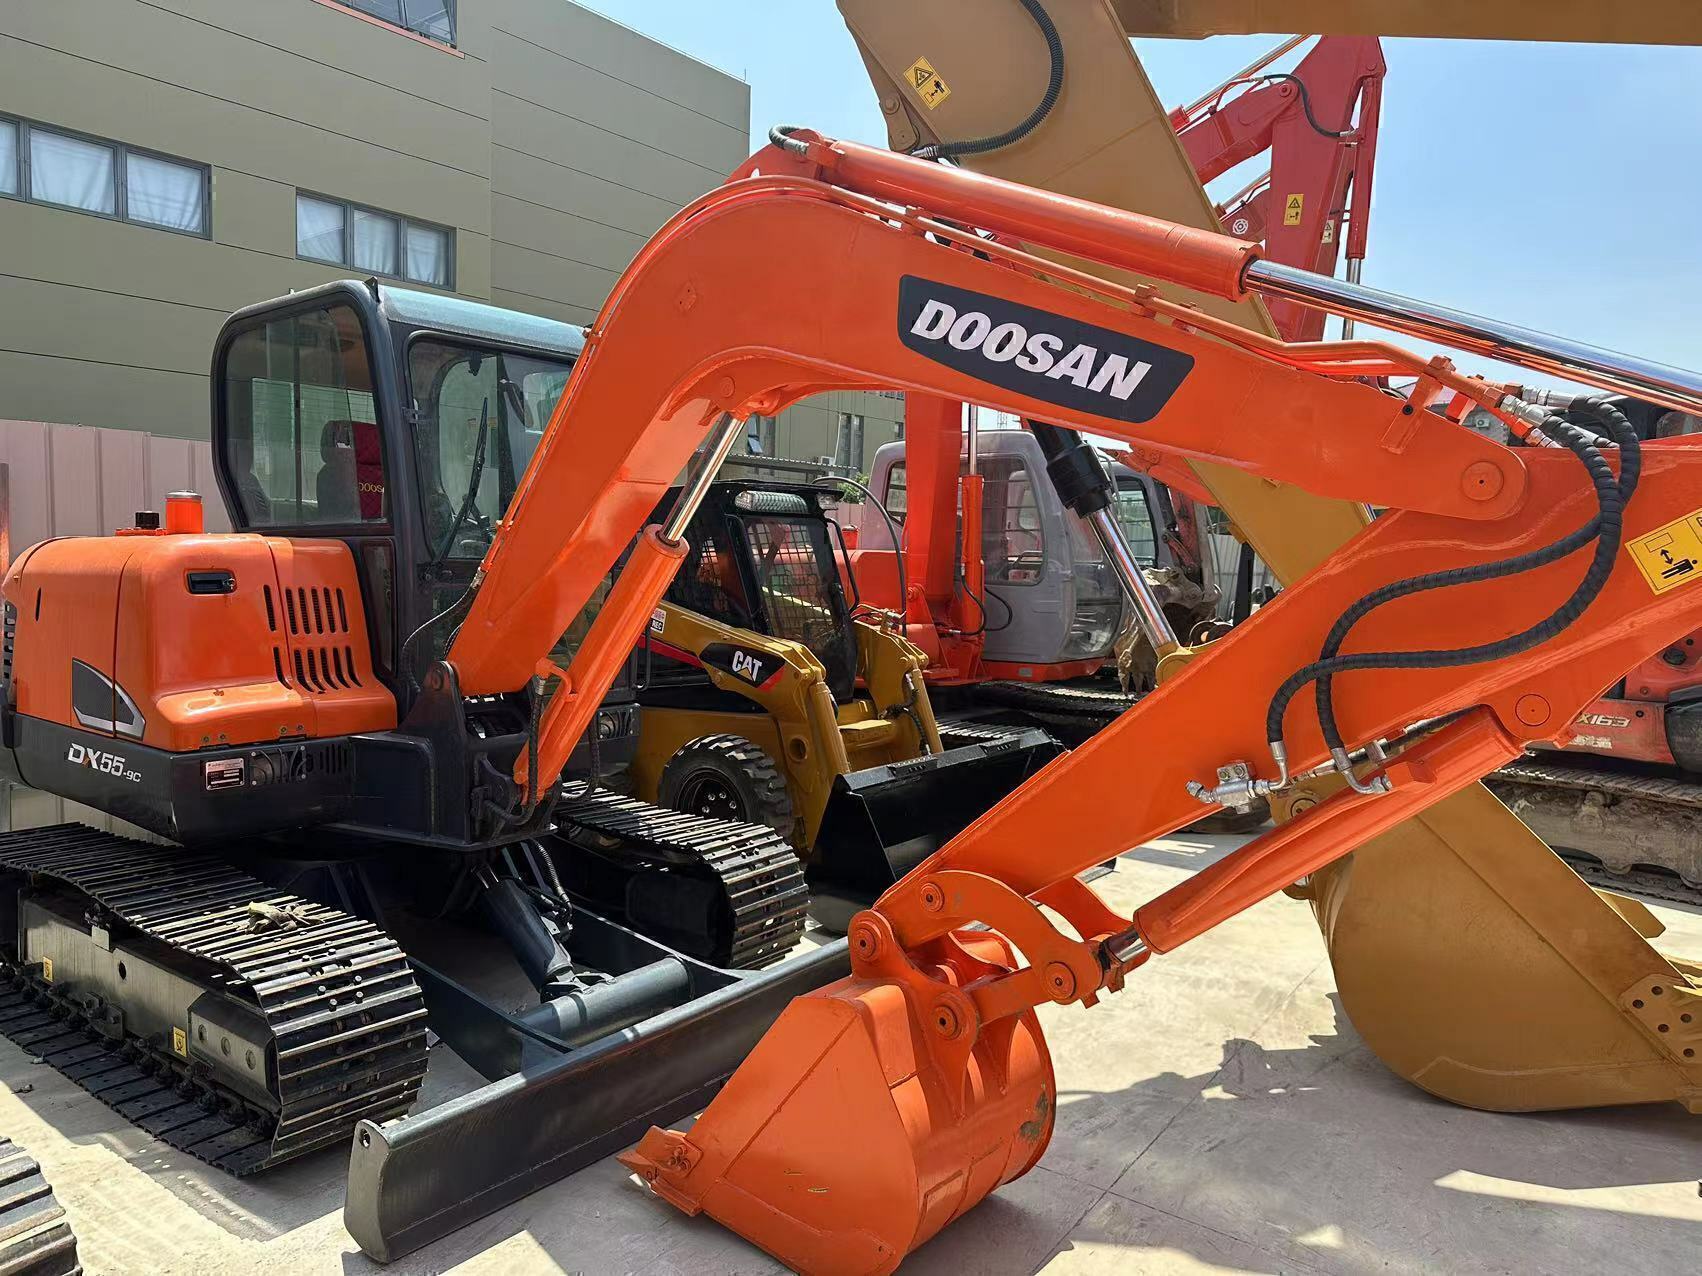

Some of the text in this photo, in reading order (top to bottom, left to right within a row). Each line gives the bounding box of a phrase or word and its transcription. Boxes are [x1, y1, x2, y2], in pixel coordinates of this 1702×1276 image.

[910, 299, 1152, 401] DOOSAN
[359, 482, 384, 493] DOOS
[732, 650, 763, 682] CAT
[1576, 712, 1631, 728] X163
[67, 742, 142, 783] DX55-9C
